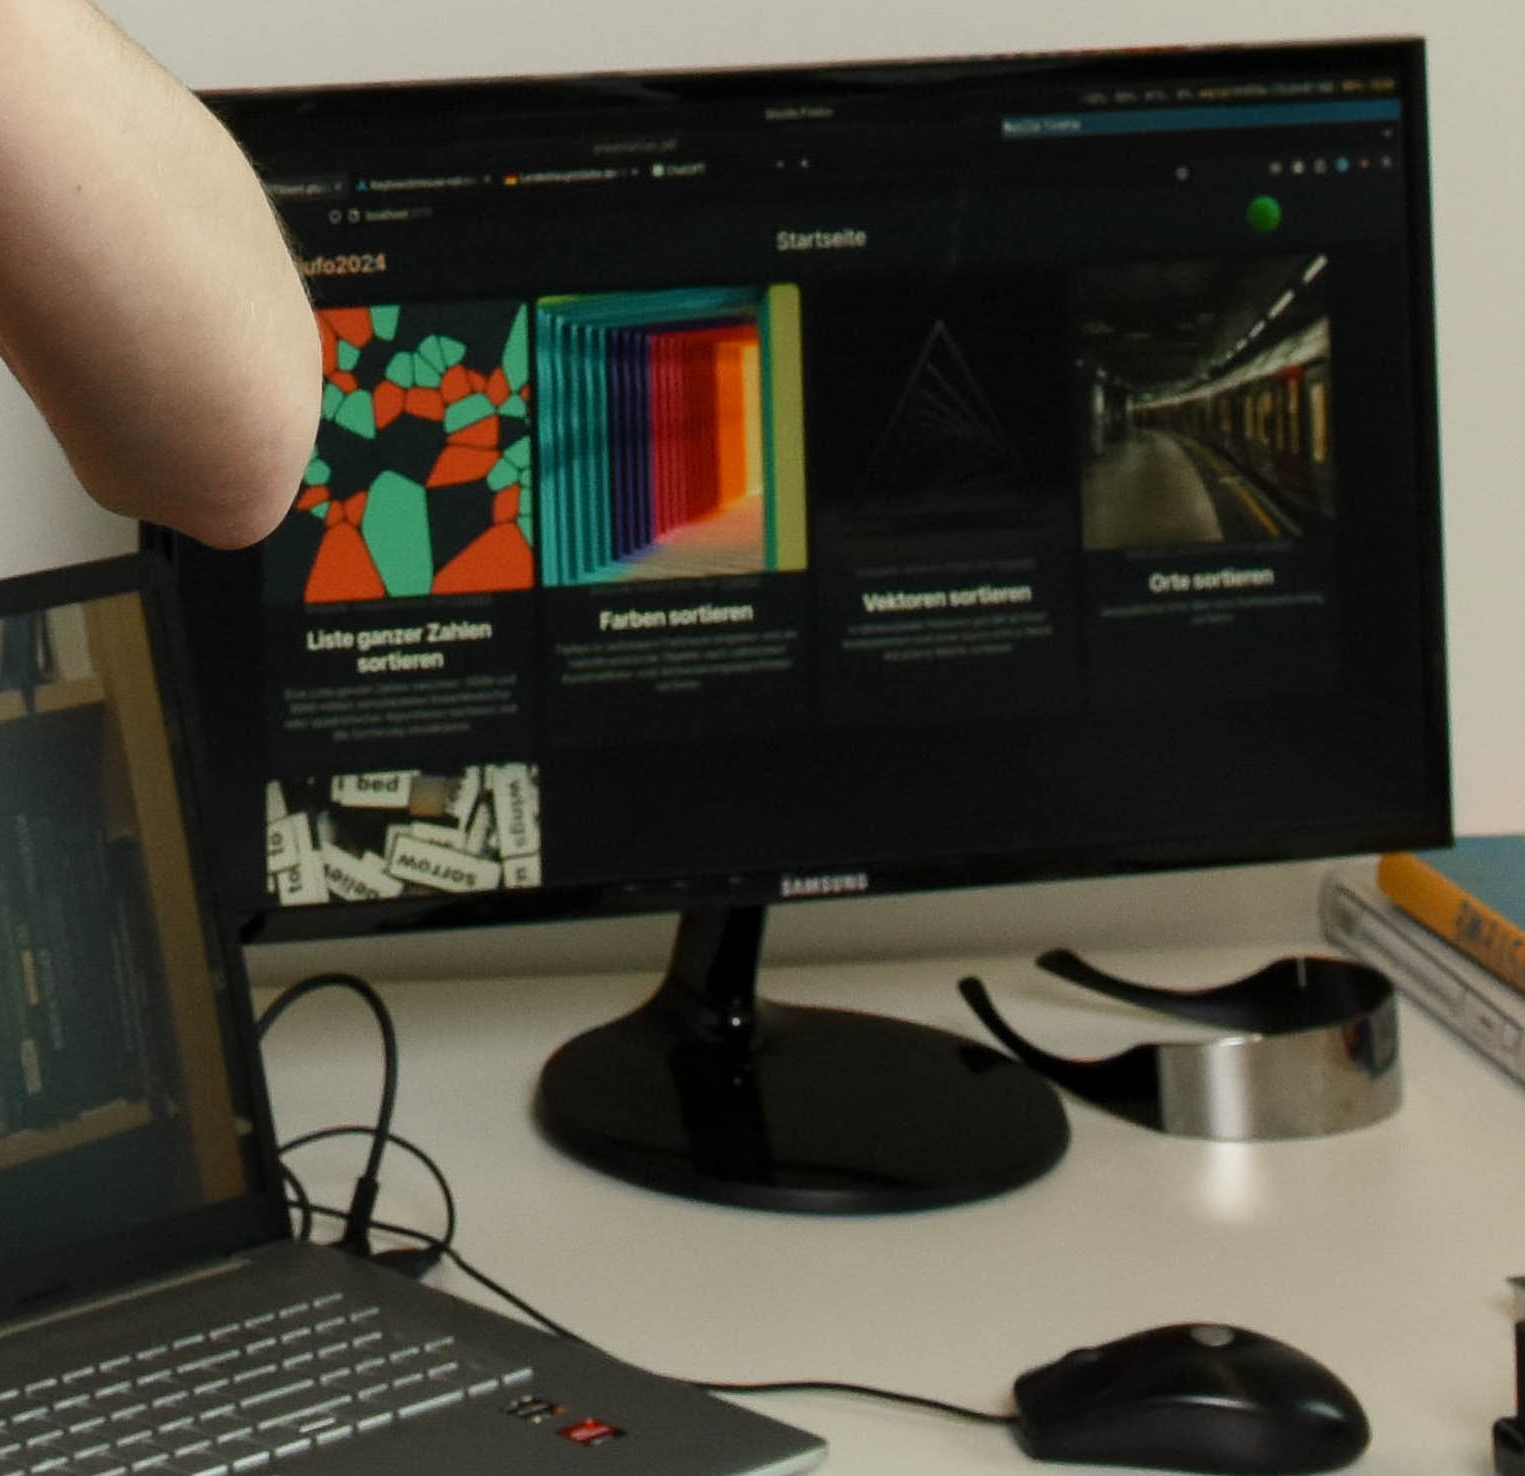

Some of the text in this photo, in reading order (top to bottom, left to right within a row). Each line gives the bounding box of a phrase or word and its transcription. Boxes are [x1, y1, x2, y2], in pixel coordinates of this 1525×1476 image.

[777, 229, 867, 251] Startseite
[1149, 569, 1274, 592] Orte sortieren
[862, 586, 1032, 612] Vektoren sortieren
[599, 605, 754, 630] Farben sortieren
[306, 621, 493, 652] Liste ganzer Zahlen
[357, 647, 445, 673] sortieren
